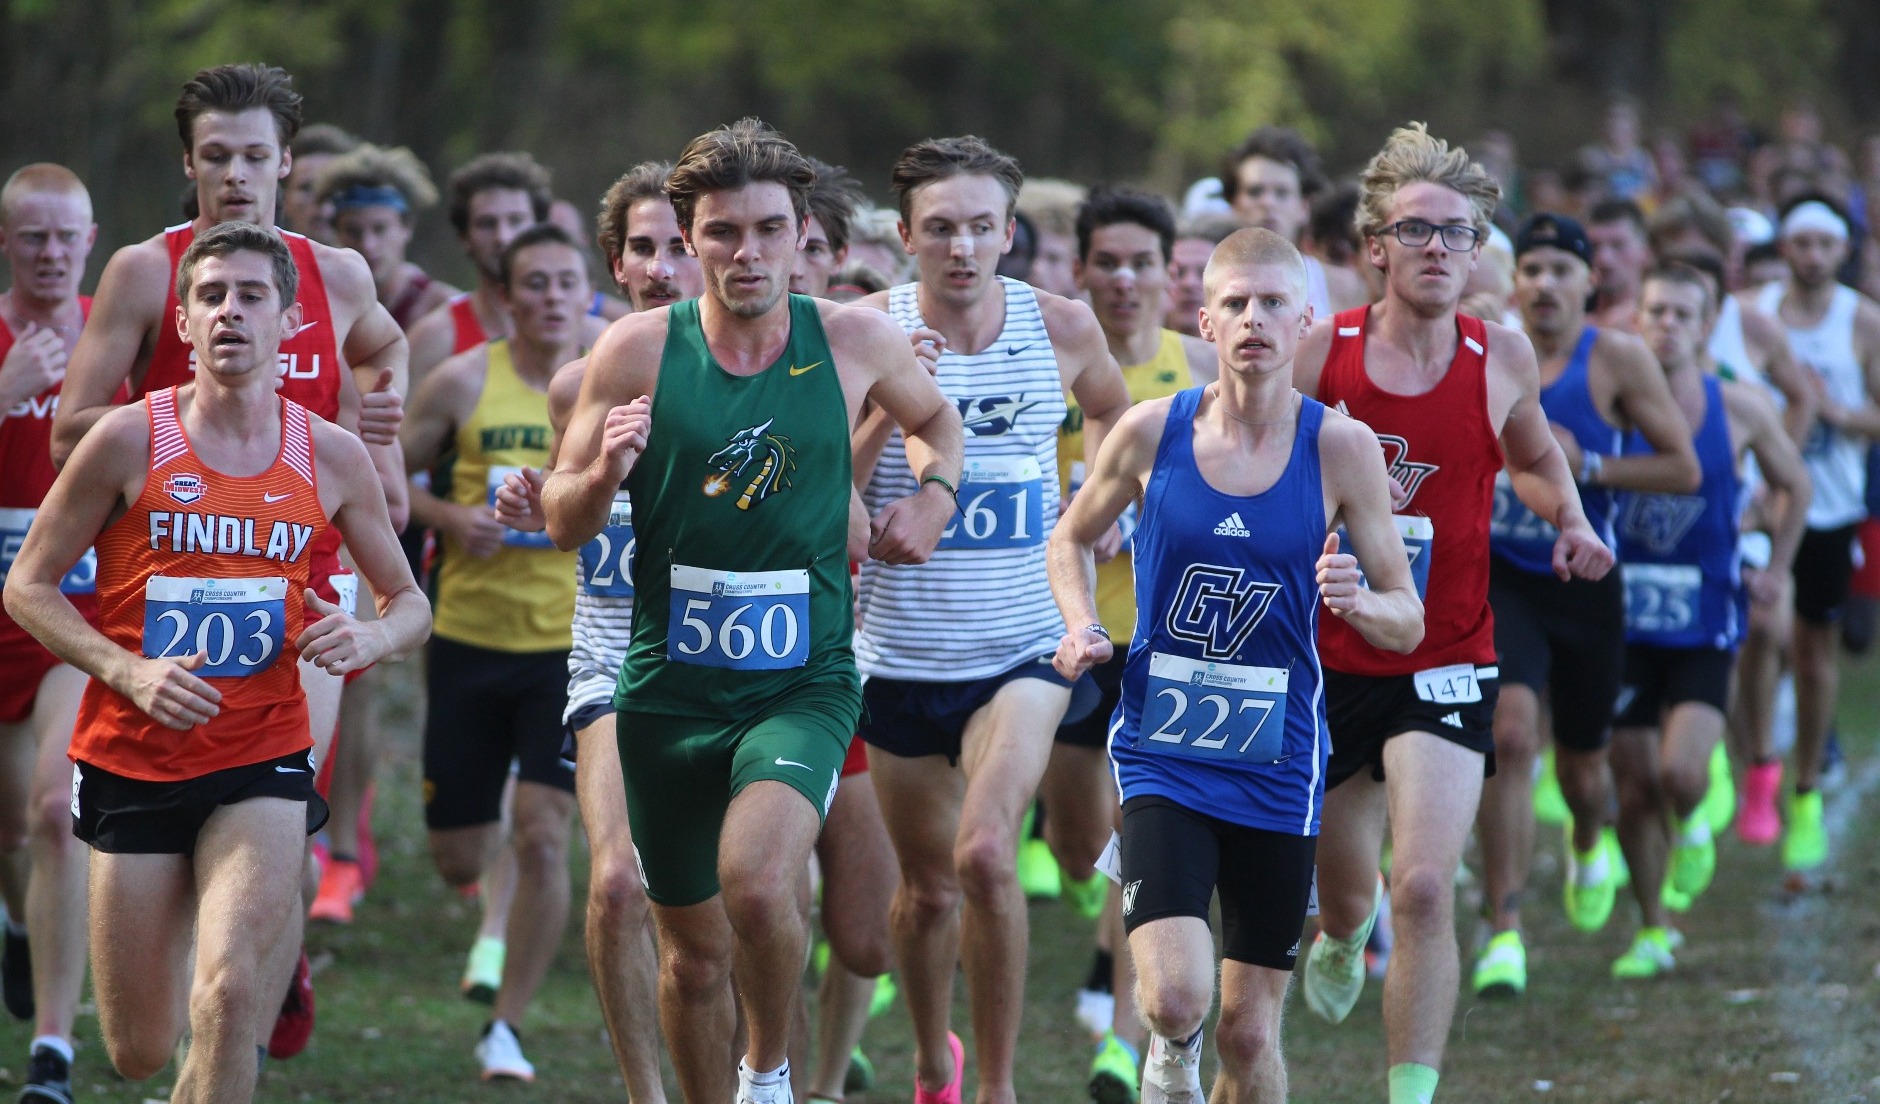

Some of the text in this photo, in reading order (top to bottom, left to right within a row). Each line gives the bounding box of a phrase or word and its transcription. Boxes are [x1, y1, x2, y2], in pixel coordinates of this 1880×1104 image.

[165, 481, 207, 494] MIDWEST
[149, 511, 313, 563] FINDLAY
[1214, 527, 1250, 537] adidas
[156, 609, 273, 666] 203
[677, 598, 798, 660] 560
[1166, 562, 1283, 660] GV
[1426, 675, 1472, 700] 147
[1148, 687, 1276, 753] 227
